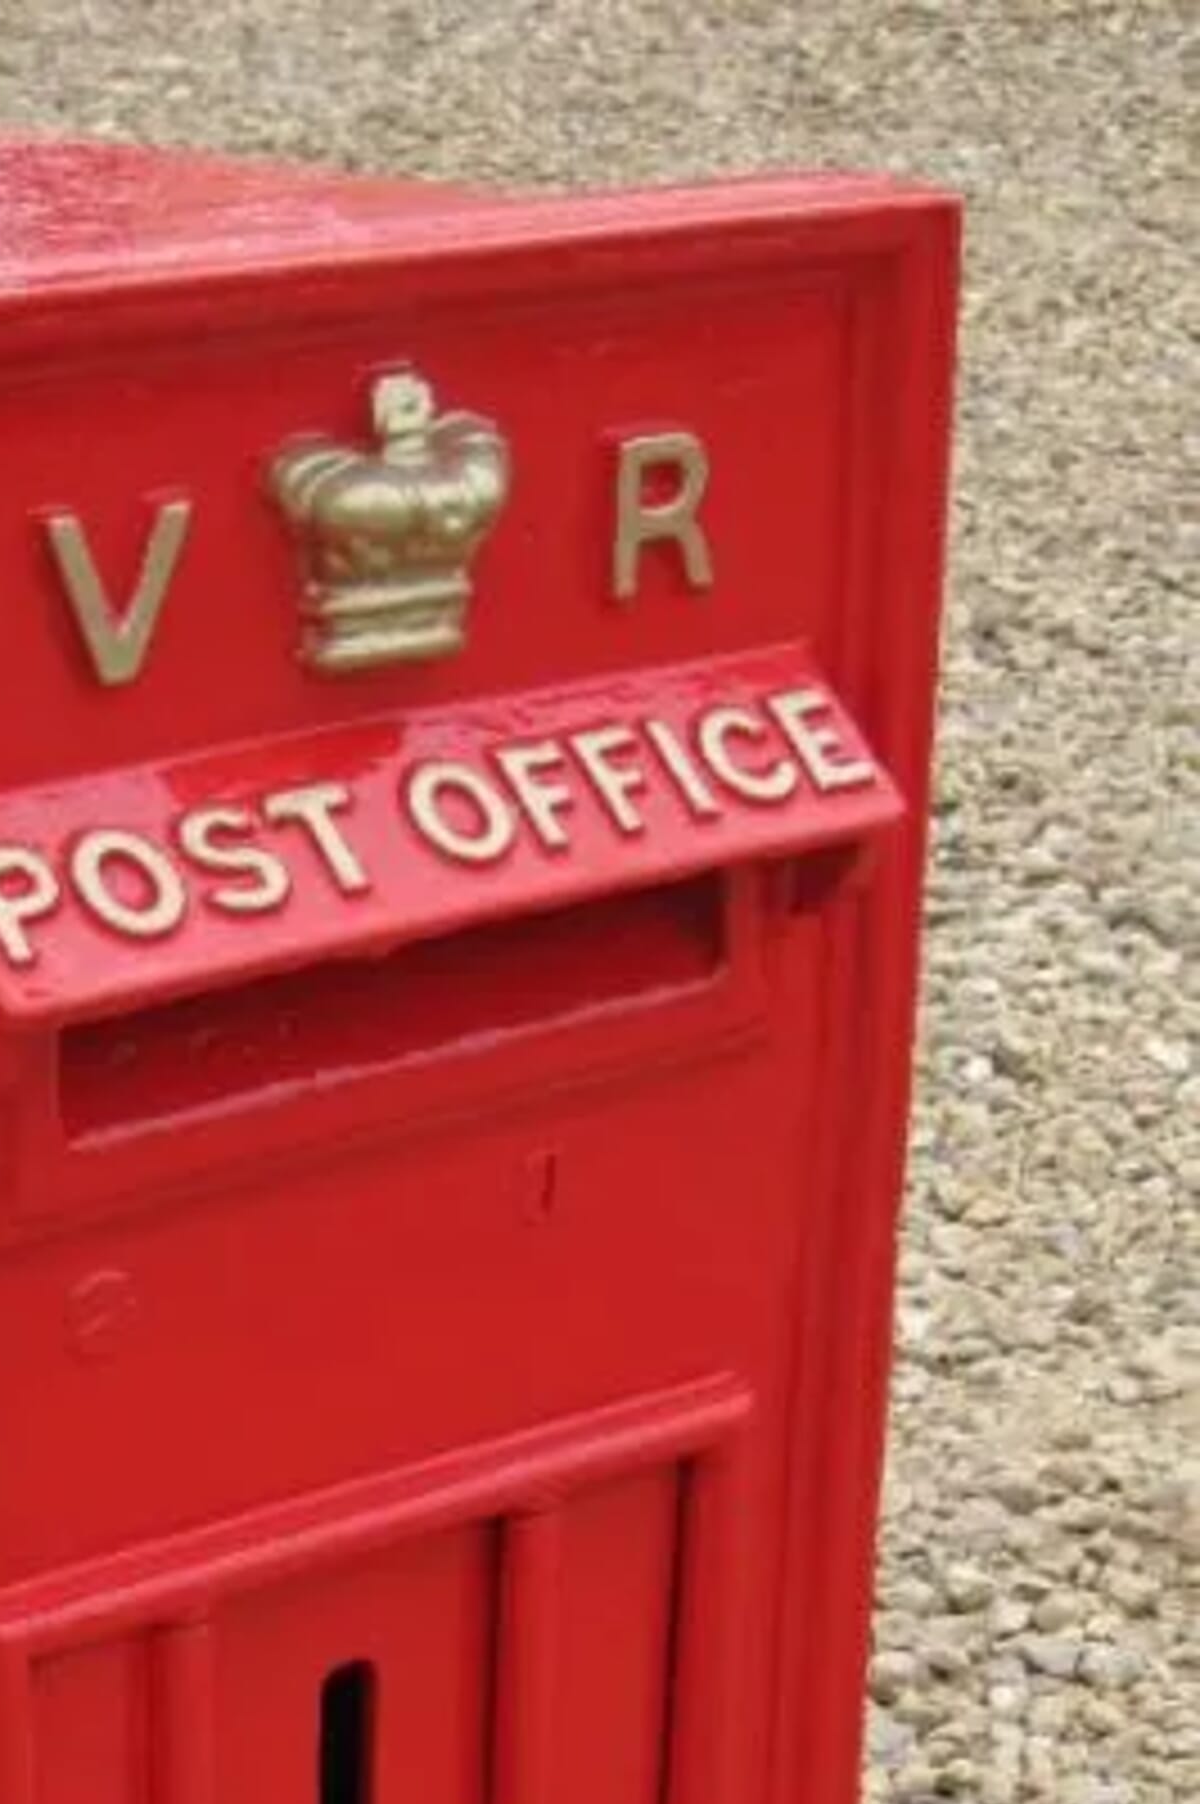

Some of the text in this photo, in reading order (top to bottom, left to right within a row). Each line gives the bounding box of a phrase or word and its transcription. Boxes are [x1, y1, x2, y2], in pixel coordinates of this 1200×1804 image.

[42, 428, 714, 686] V R
[407, 688, 877, 862] OFFICE
